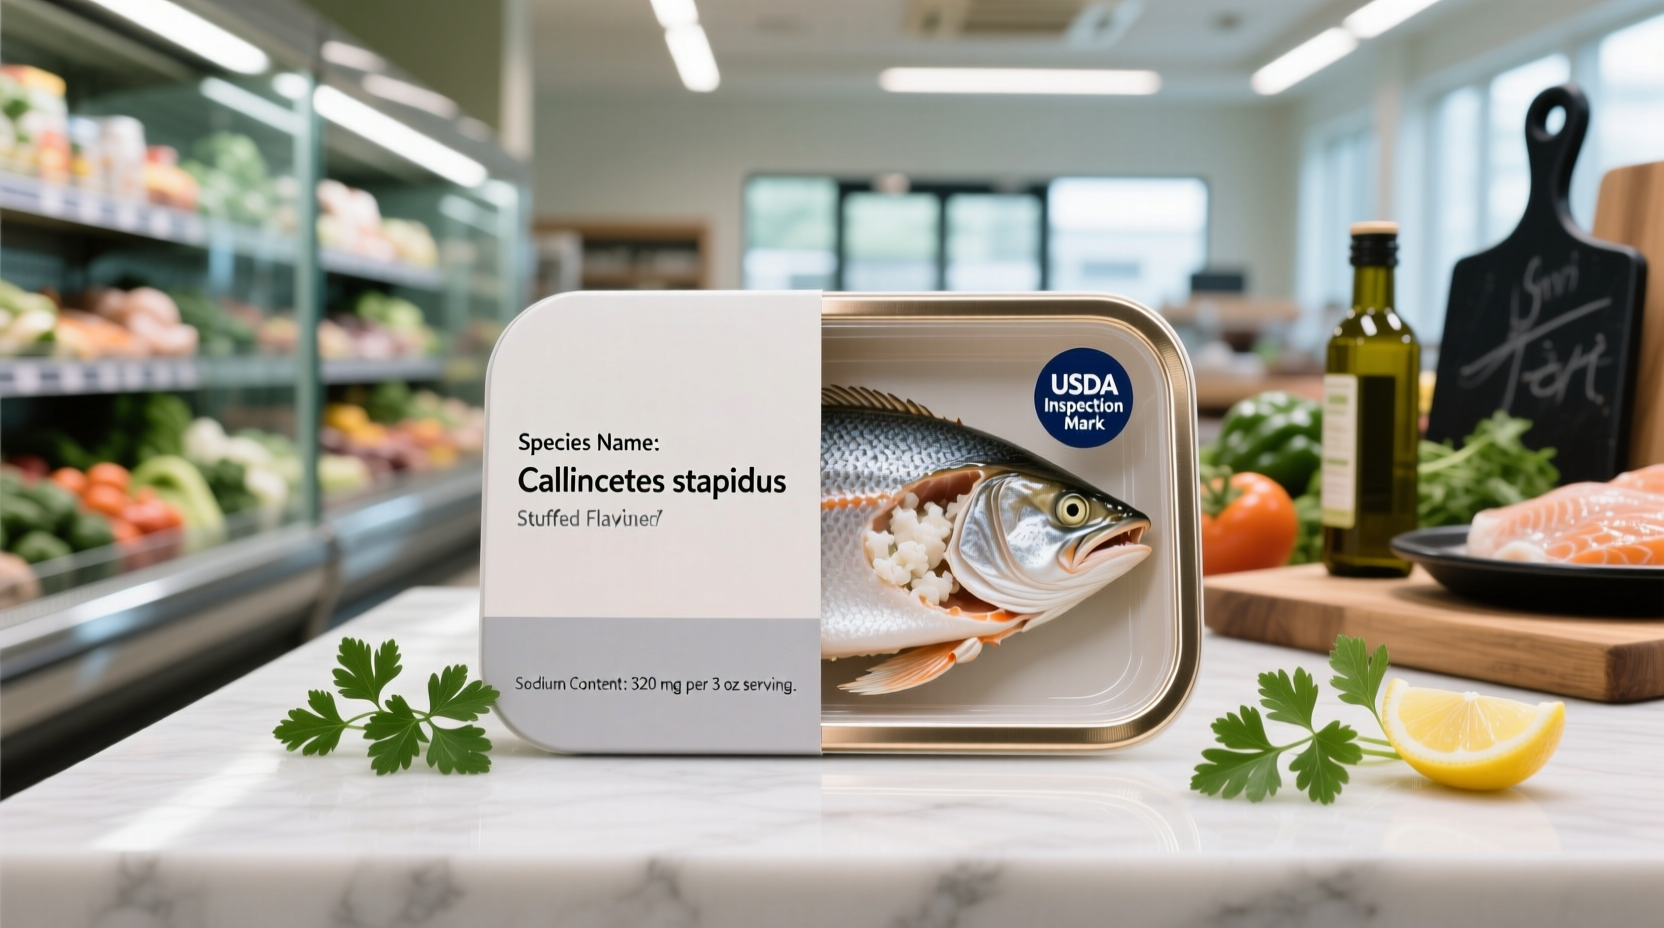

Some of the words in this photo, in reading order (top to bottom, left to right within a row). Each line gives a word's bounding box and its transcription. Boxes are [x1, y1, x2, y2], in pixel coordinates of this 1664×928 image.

[1051, 373, 1119, 395] USDA
[1044, 398, 1124, 416] Inspection
[1064, 414, 1106, 431] Mark
[517, 432, 592, 456] Species
[597, 432, 660, 452] Name:
[517, 465, 666, 494] Callincetes
[672, 466, 787, 500] stapidus
[517, 509, 580, 527] Stuffed
[515, 676, 567, 691] Sodium
[569, 676, 628, 691] Content:
[631, 676, 657, 691] 320
[660, 680, 682, 696] mg
[686, 680, 709, 696] per
[712, 676, 721, 691] 3
[723, 681, 741, 692] oz
[743, 676, 798, 696] serving.
